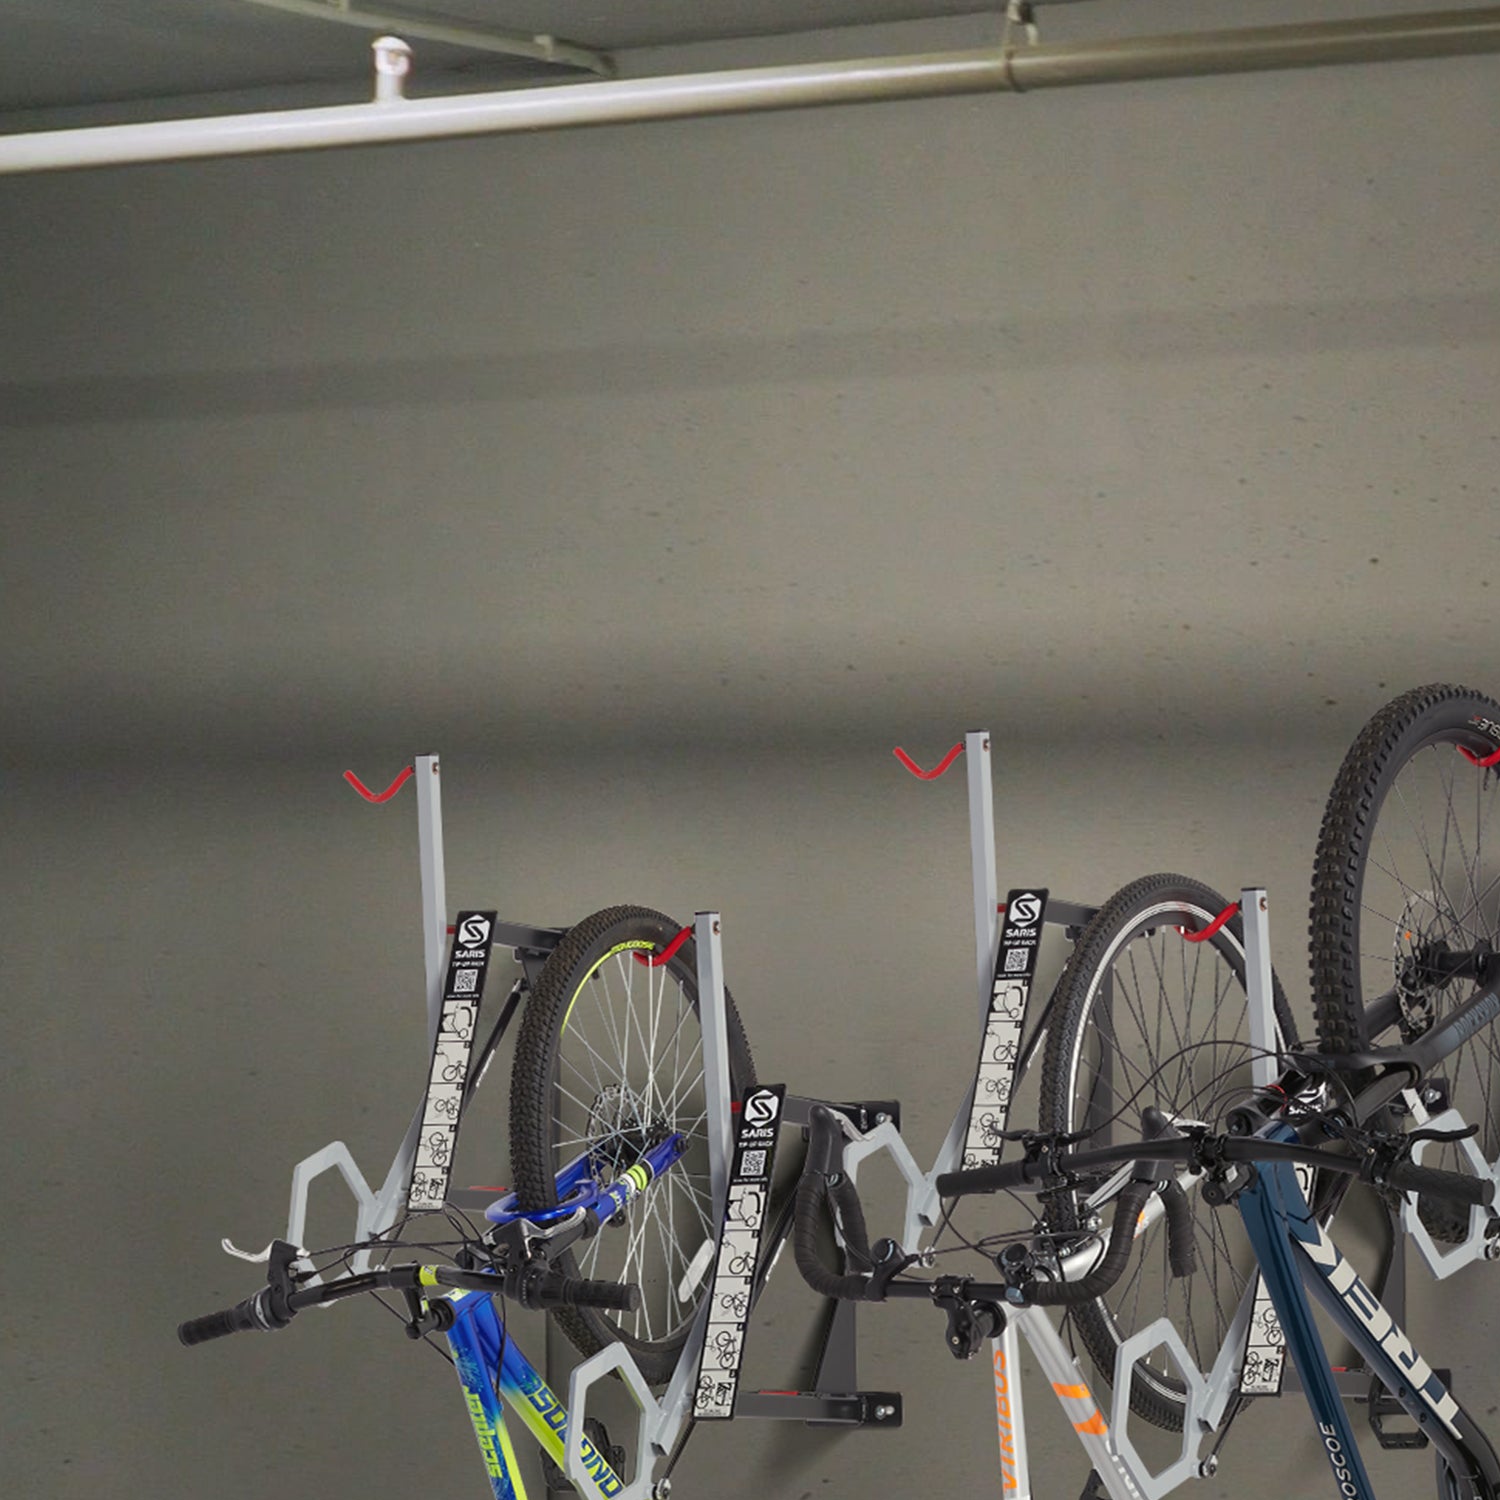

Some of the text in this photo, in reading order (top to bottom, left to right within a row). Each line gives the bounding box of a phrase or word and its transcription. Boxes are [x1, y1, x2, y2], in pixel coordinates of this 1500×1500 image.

[1005, 928, 1037, 938] SARIS
[455, 949, 486, 959] SARIS
[741, 1128, 774, 1139] SARIS
[1299, 1223, 1463, 1439] TREK
[993, 1350, 1018, 1492] VIRIBUS
